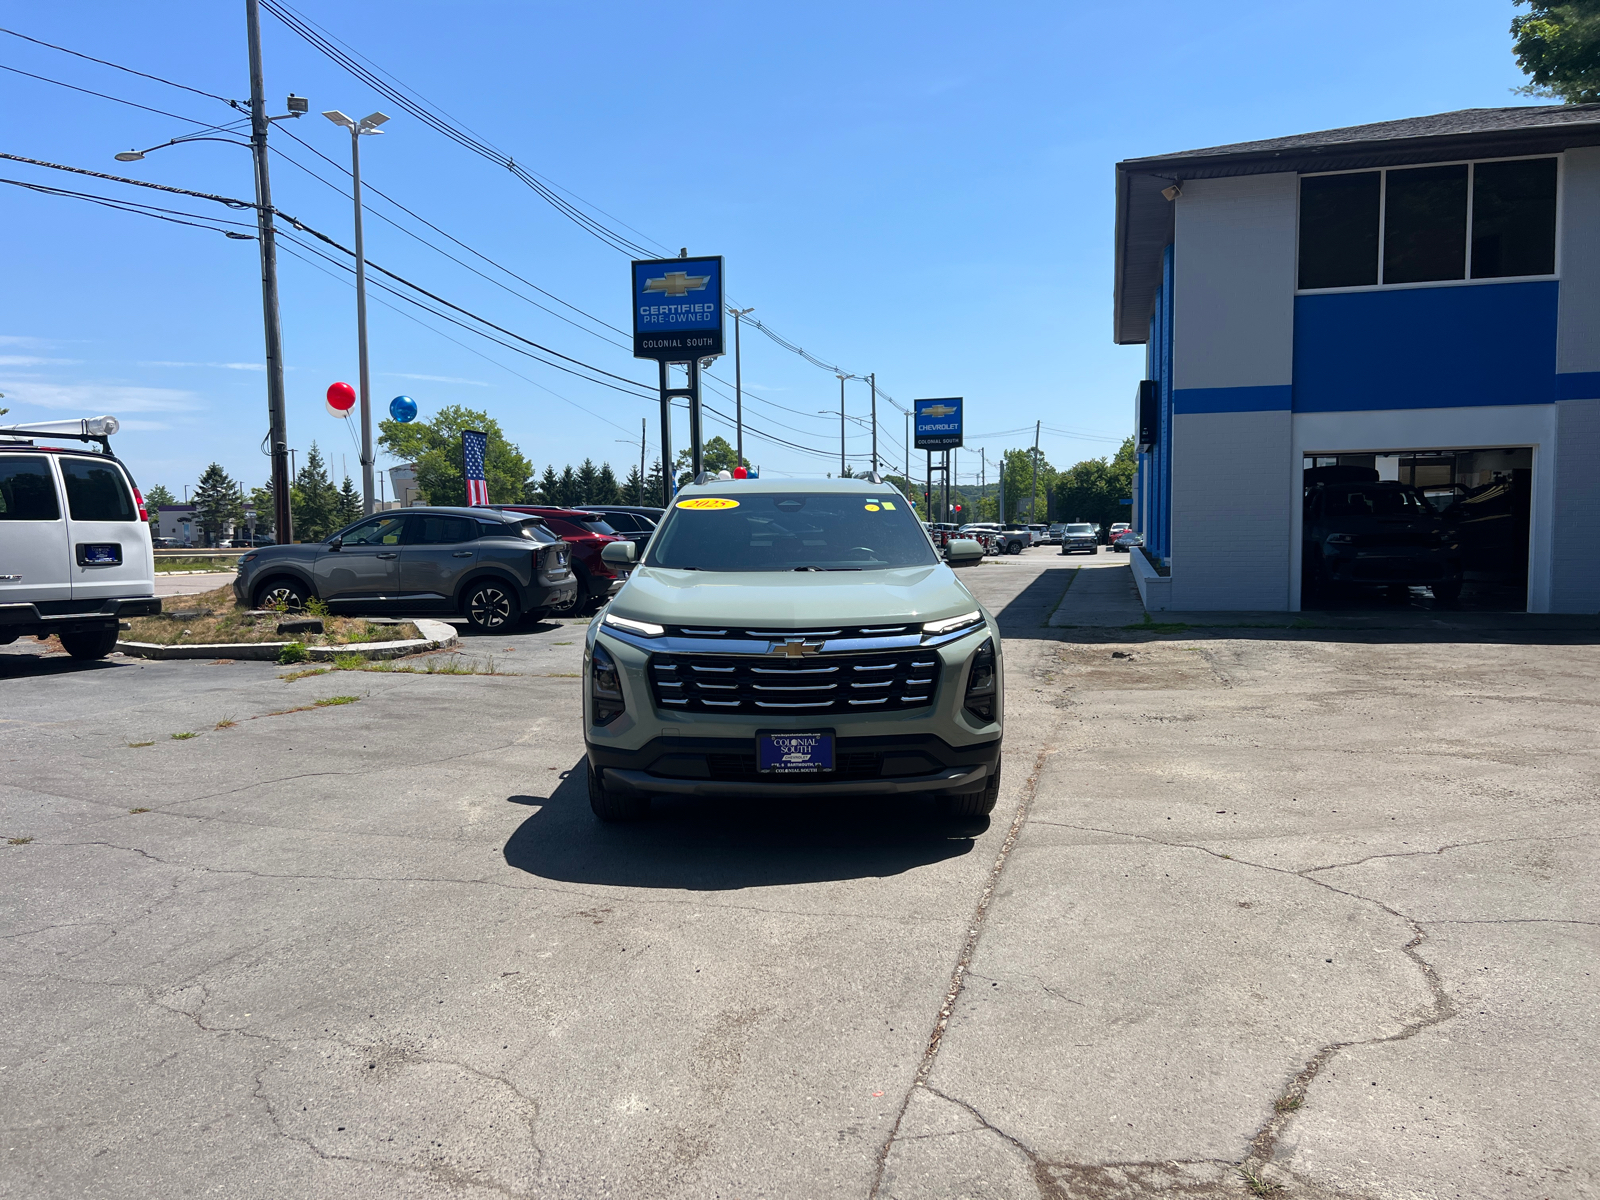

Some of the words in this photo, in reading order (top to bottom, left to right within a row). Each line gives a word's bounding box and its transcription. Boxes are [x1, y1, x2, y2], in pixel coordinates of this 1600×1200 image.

[640, 303, 714, 315] CERTIFIED
[644, 312, 710, 323] PRE-OWNED
[642, 339, 682, 348] COLONIAL
[686, 338, 712, 346] SOUTH
